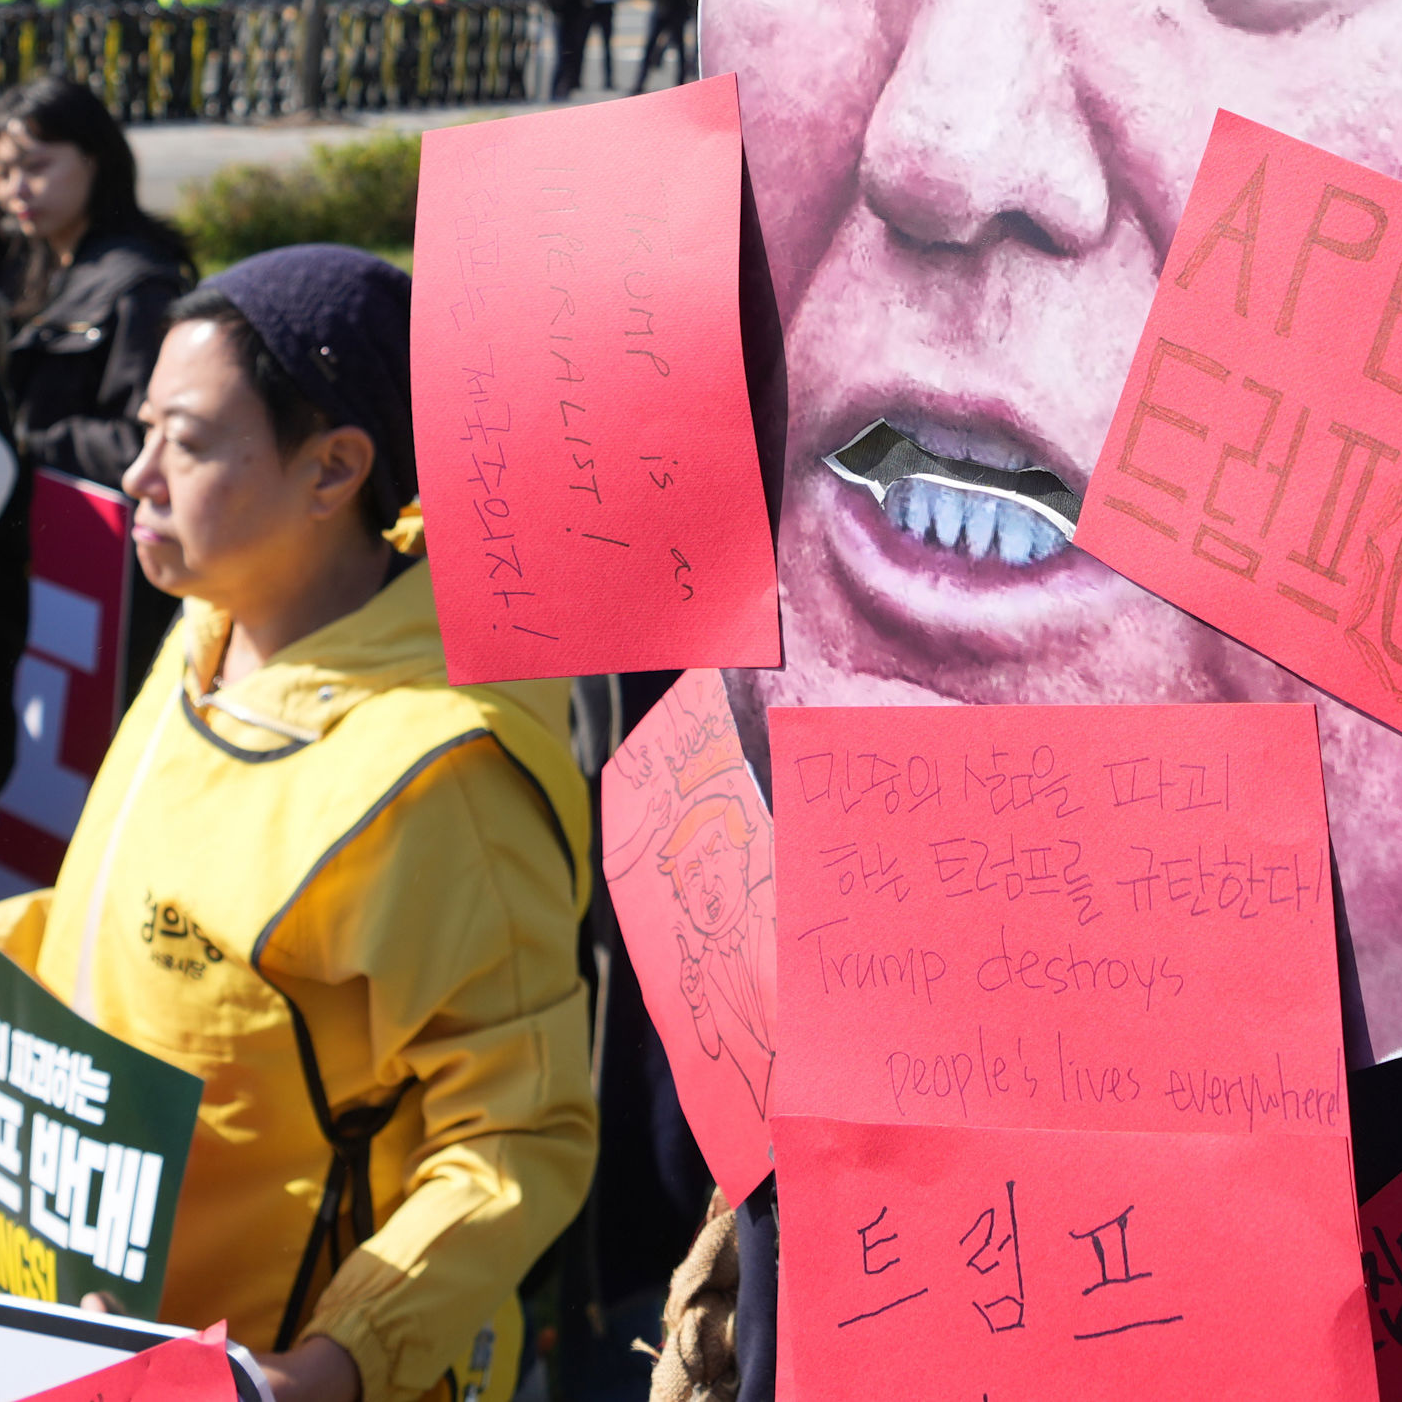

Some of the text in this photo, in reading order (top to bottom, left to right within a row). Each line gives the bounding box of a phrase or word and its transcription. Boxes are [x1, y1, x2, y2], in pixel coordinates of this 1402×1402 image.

[449, 141, 511, 332] 트럼프는
[622, 178, 695, 603] TRUMP is an
[794, 743, 1231, 819] 민중의 삶을 파괴
[818, 840, 912, 903] 하는
[929, 833, 1103, 927] 트럼프를
[797, 917, 1186, 1013] Trump destroys
[8, 1027, 111, 1126] 파괴하는
[885, 1025, 1039, 1118] people's
[1057, 1031, 1141, 1104] lives
[29, 1111, 164, 1285] 반대!
